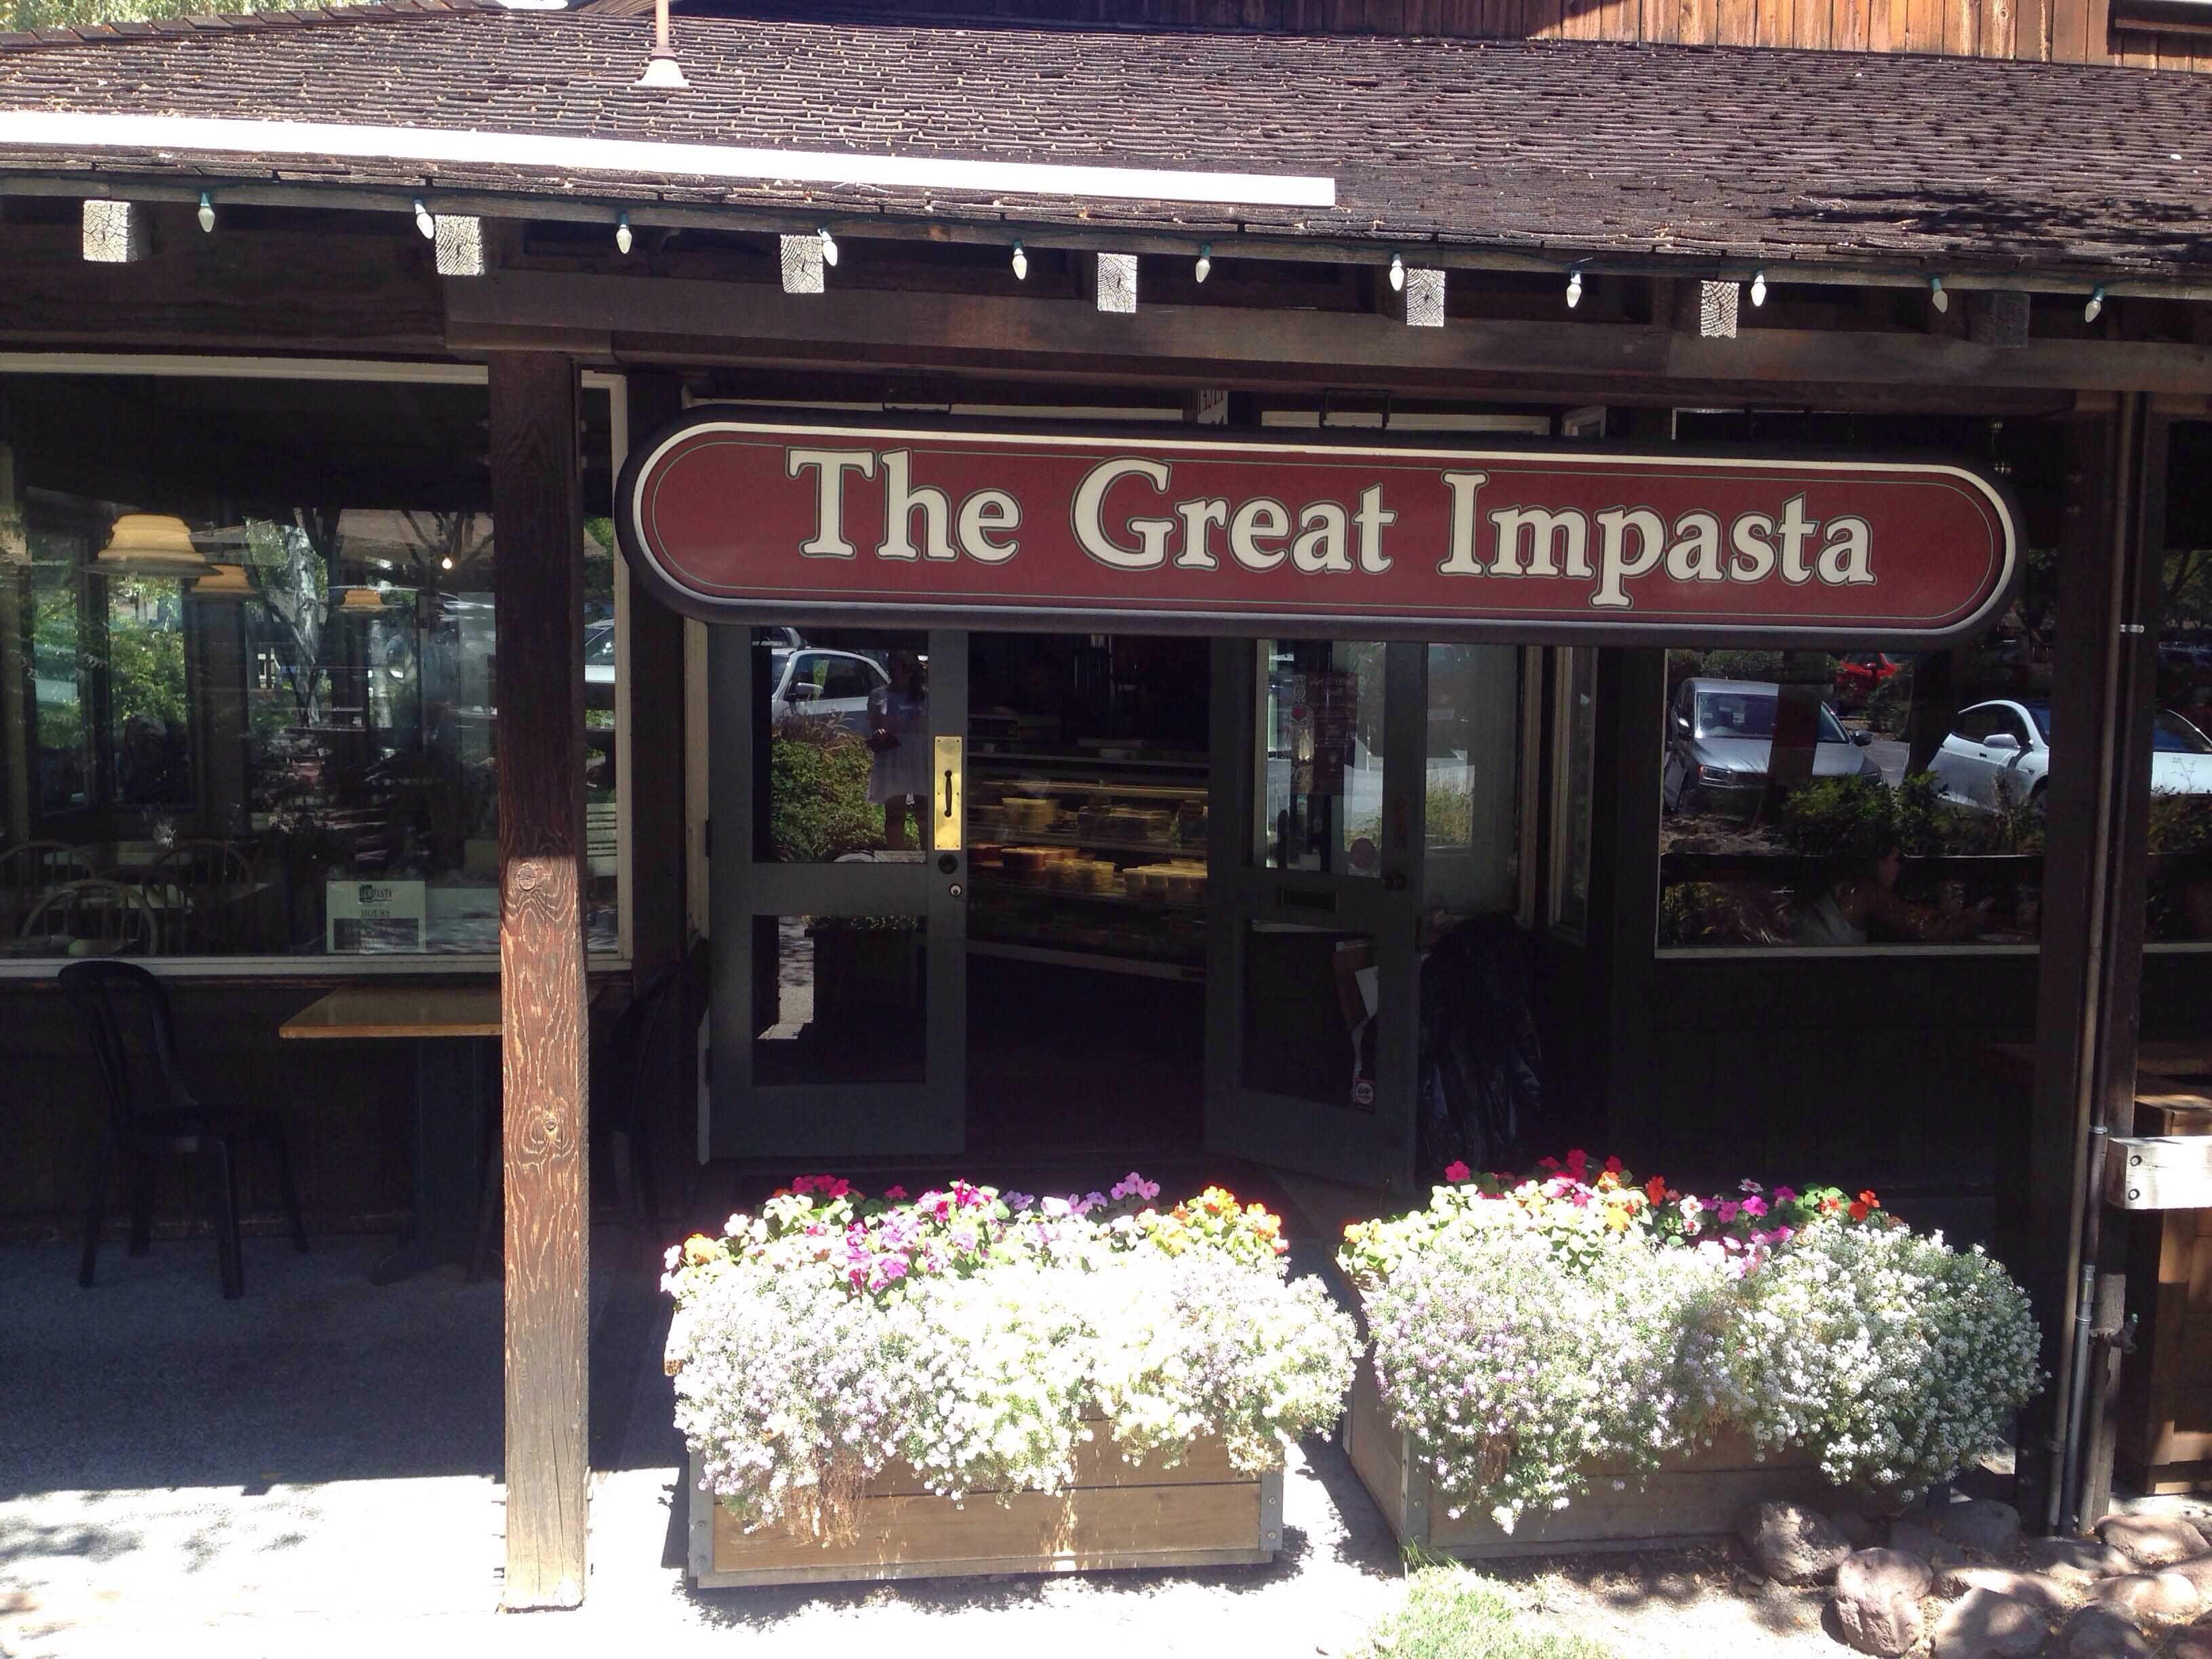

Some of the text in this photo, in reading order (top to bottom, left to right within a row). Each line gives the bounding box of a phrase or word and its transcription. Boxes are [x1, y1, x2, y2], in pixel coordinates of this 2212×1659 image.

[788, 449, 1876, 607] The Great Impasta
